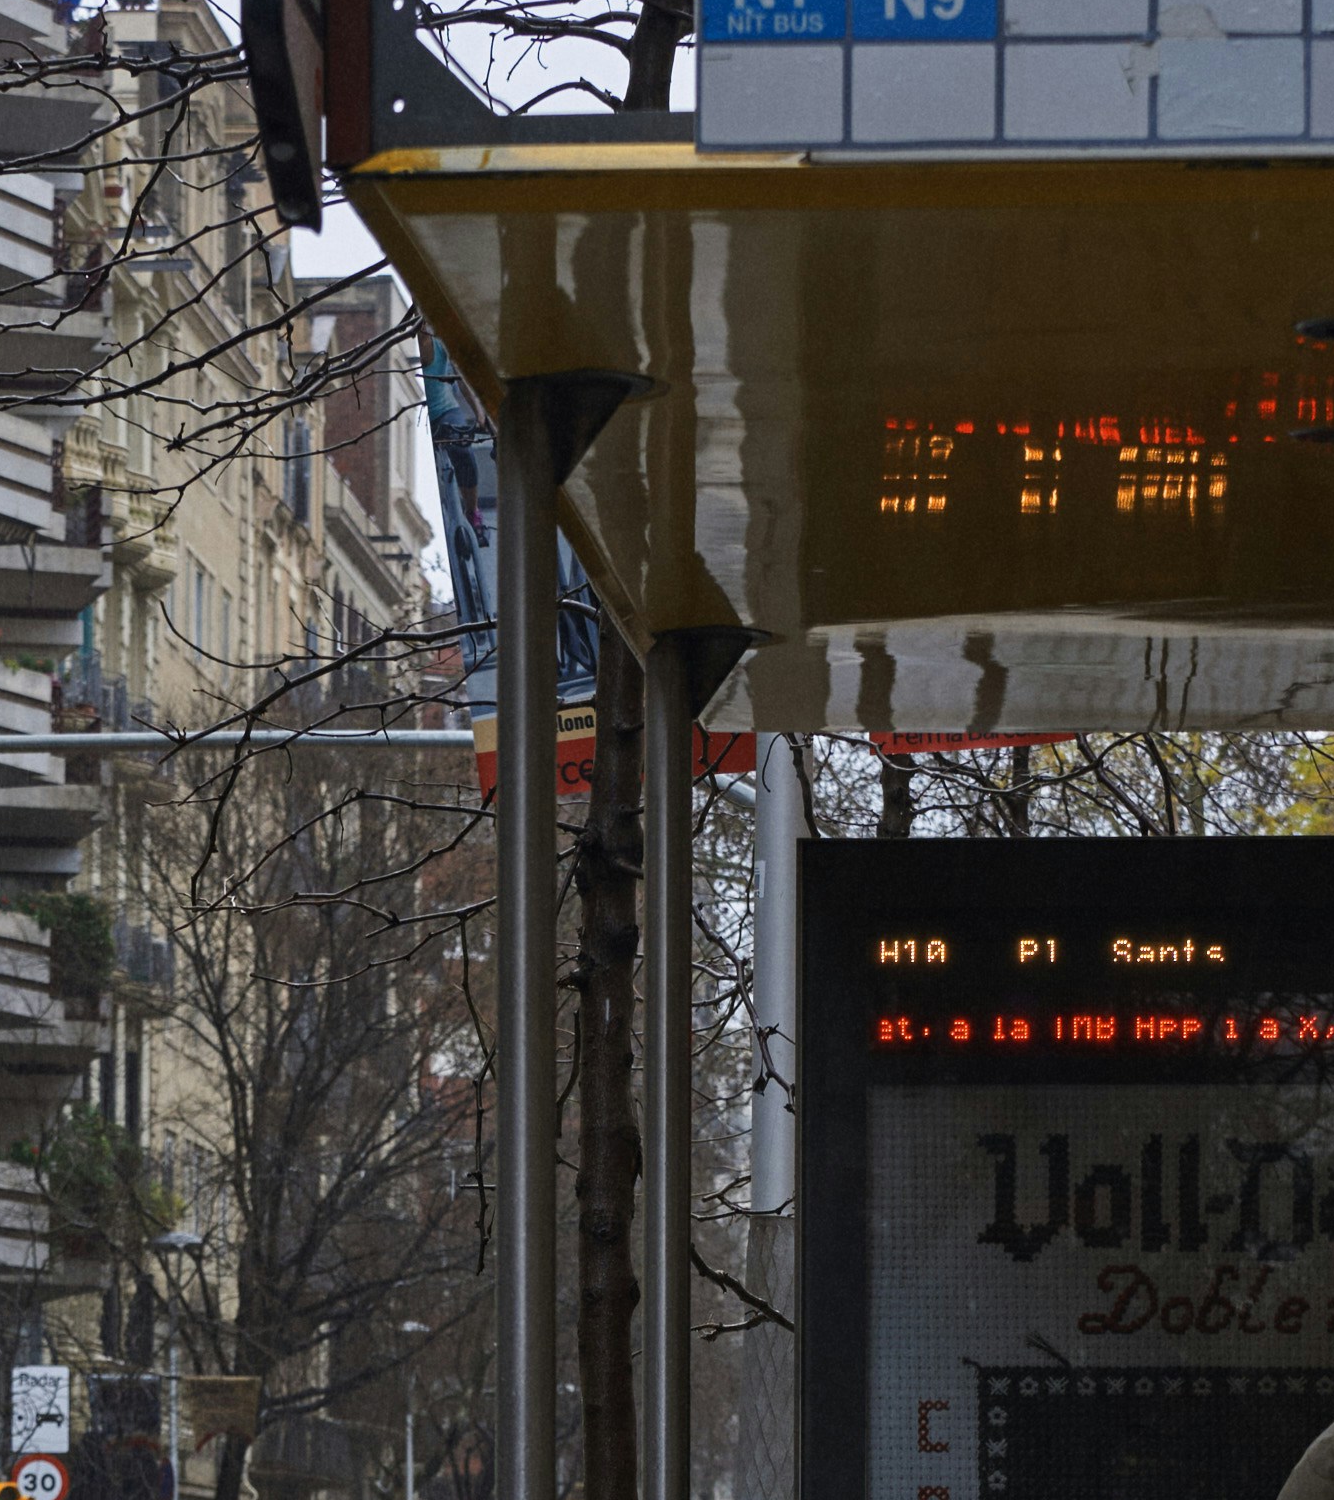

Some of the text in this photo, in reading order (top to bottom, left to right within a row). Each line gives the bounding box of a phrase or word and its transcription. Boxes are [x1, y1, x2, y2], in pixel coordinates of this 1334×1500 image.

[727, 11, 825, 34] NIT BUS
[879, 939, 946, 964] H10
[950, 1020, 969, 1040] a
[993, 1017, 1031, 1040] la
[1259, 1020, 1278, 1040] a
[1076, 1263, 1311, 1335] Doble
[18, 1372, 63, 1388] Radar
[23, 1473, 56, 1493] 30
